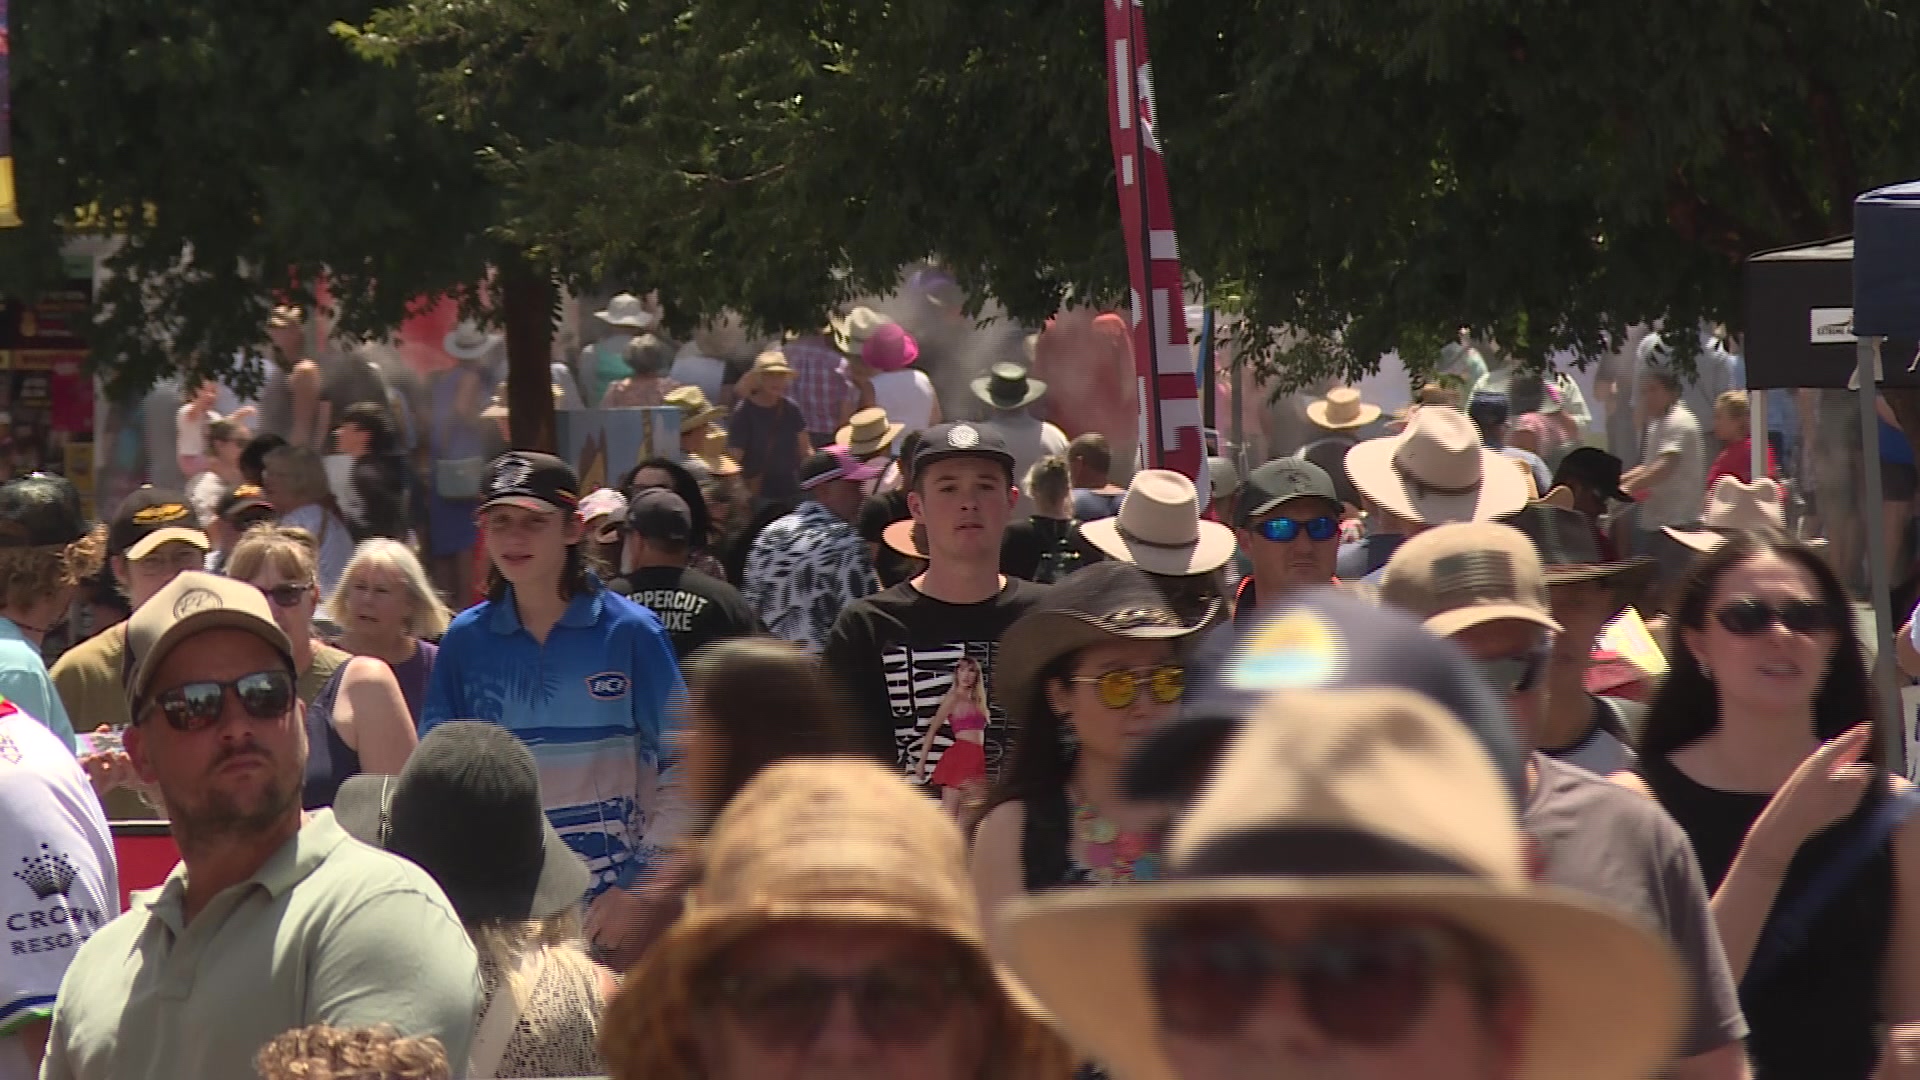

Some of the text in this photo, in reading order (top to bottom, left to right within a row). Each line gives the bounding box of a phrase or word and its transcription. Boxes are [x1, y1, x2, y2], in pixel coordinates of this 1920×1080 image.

[626, 589, 708, 615] PPERCUT
[661, 611, 692, 631] UXE
[882, 646, 912, 718] THE
[6, 905, 101, 931] CROWN
